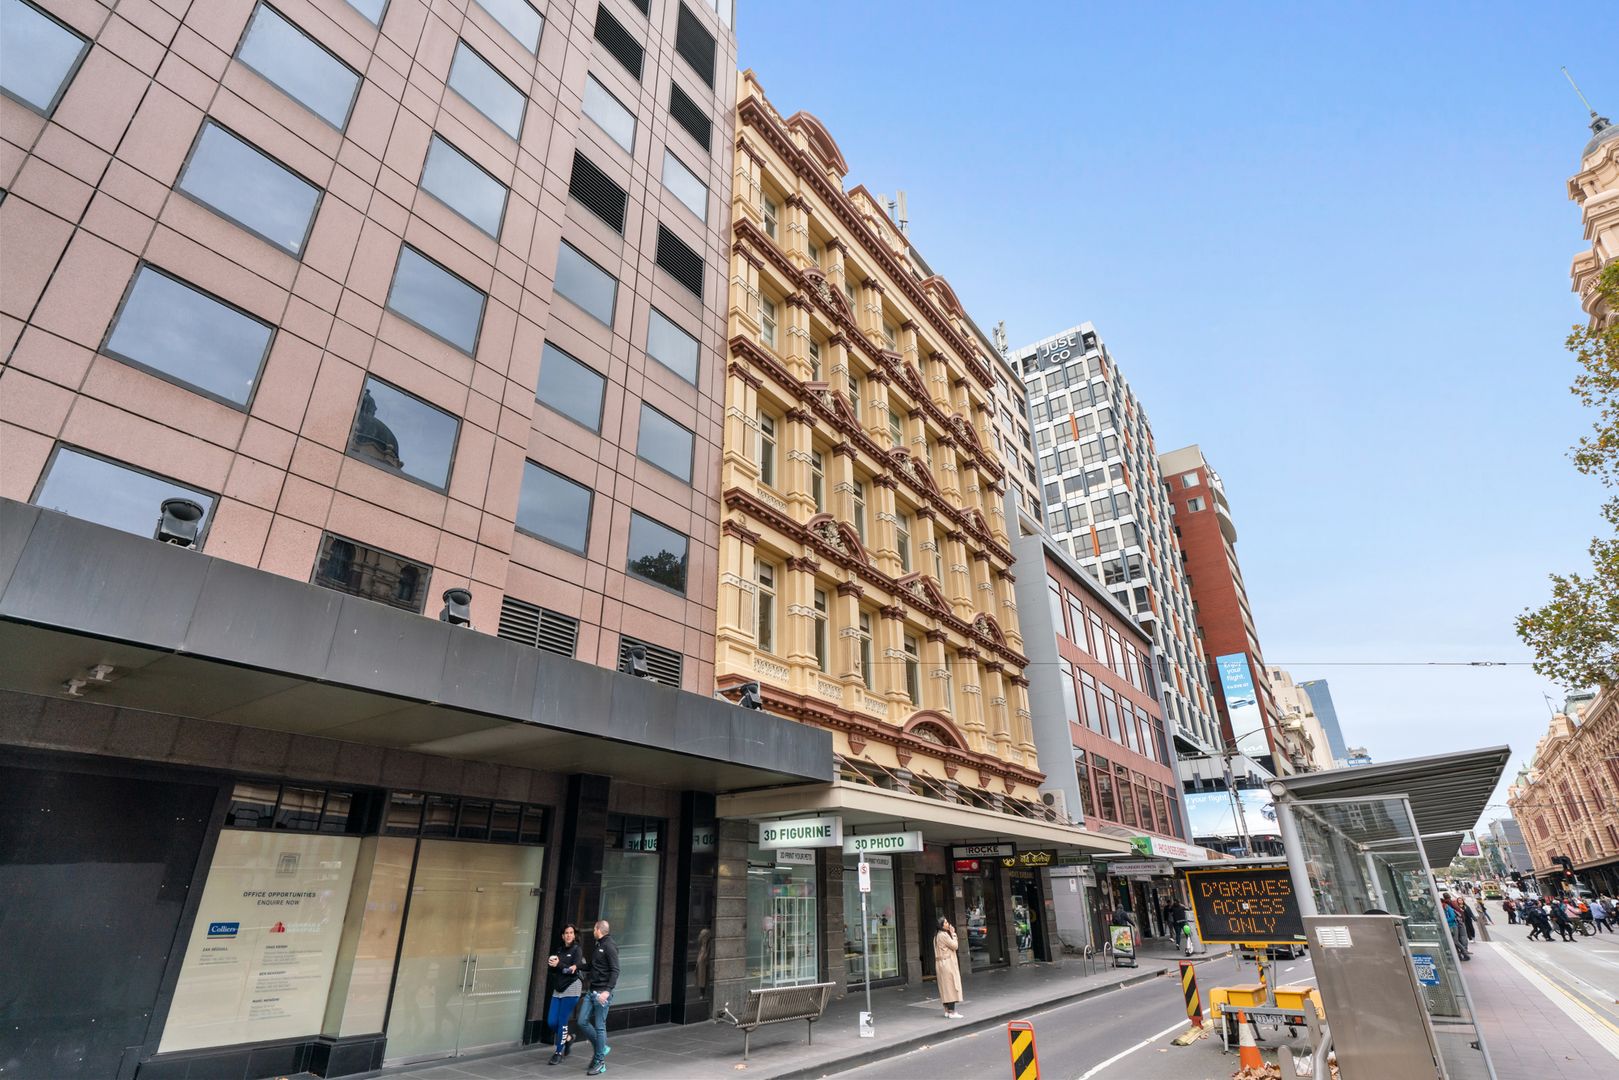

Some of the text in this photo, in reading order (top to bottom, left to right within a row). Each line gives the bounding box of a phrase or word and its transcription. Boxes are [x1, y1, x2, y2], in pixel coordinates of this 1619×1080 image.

[1051, 349, 1071, 363] CO
[764, 825, 832, 841] 3D FIGURINE
[855, 836, 904, 850] 3D PHOTO
[1201, 879, 1291, 897] D'GRAVES
[1213, 898, 1285, 915] ACCESS
[211, 925, 236, 933] Colliers
[1229, 917, 1276, 934] ONLY
